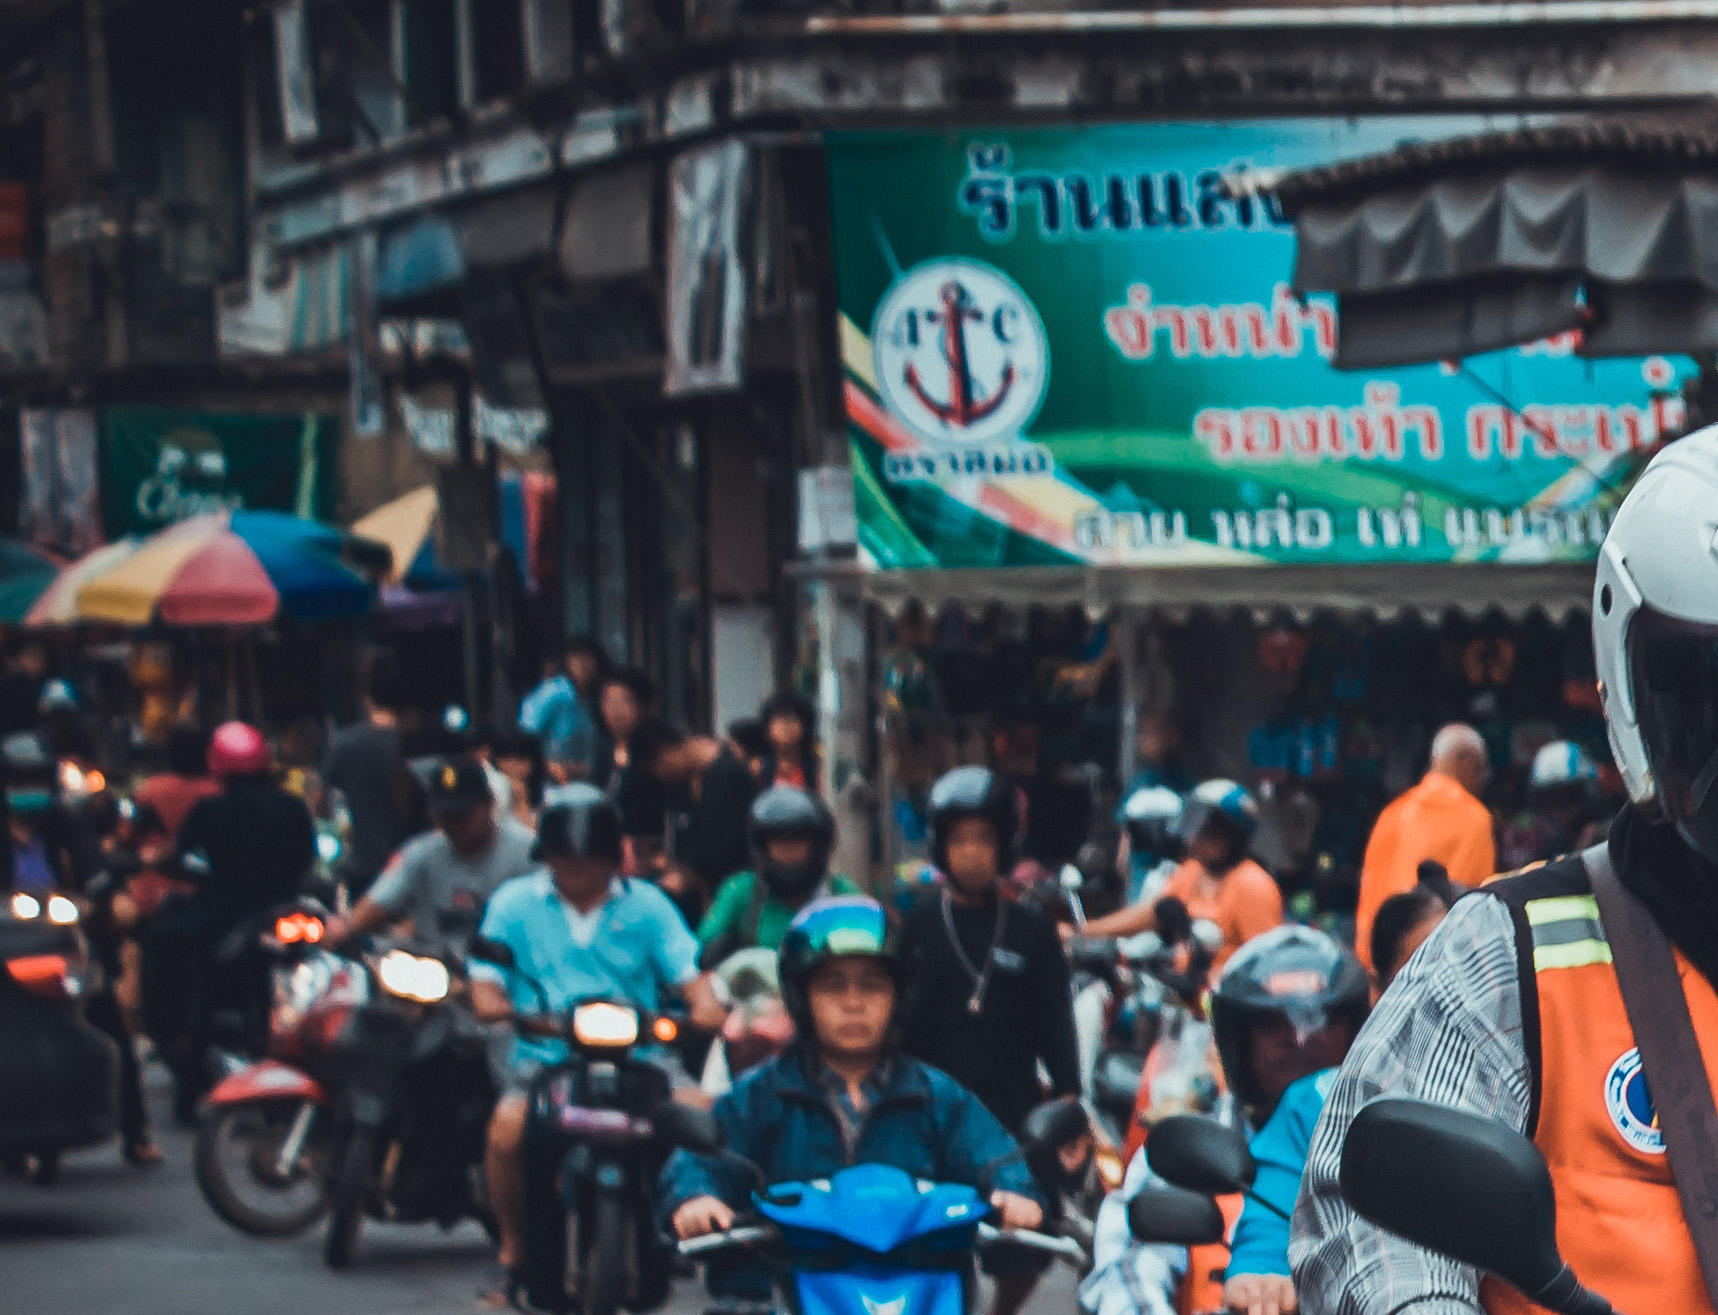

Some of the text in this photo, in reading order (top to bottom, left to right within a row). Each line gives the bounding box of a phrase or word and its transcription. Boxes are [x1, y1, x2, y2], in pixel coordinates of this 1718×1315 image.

[1106, 284, 1336, 356] จำหน่า
[1197, 384, 1441, 457] รองเท้า
